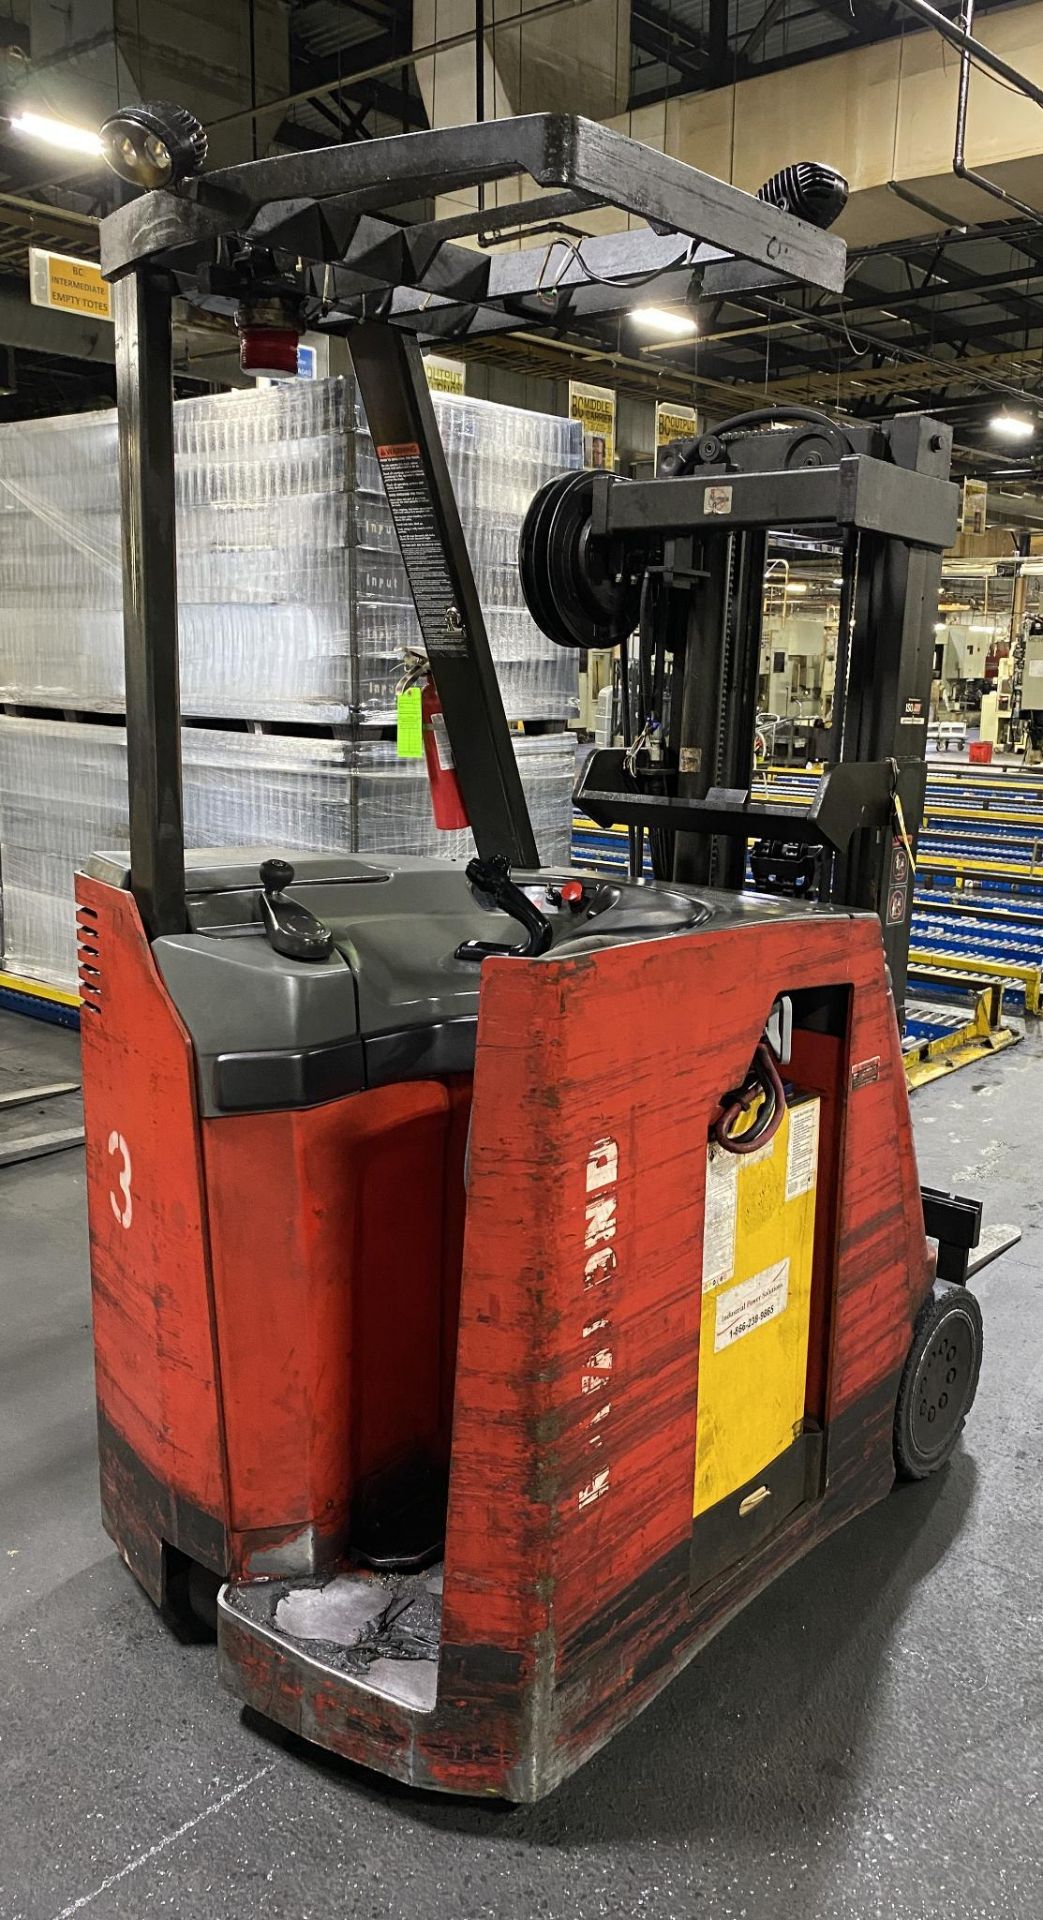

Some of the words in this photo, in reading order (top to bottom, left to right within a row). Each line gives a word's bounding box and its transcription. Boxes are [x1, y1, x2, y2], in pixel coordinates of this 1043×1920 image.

[72, 266, 84, 276] BC
[51, 276, 105, 295] INTERMEDIATE
[52, 291, 81, 305] EMPTY
[83, 298, 108, 311] TOTES
[367, 573, 398, 588] Input
[108, 1130, 132, 1229] 3
